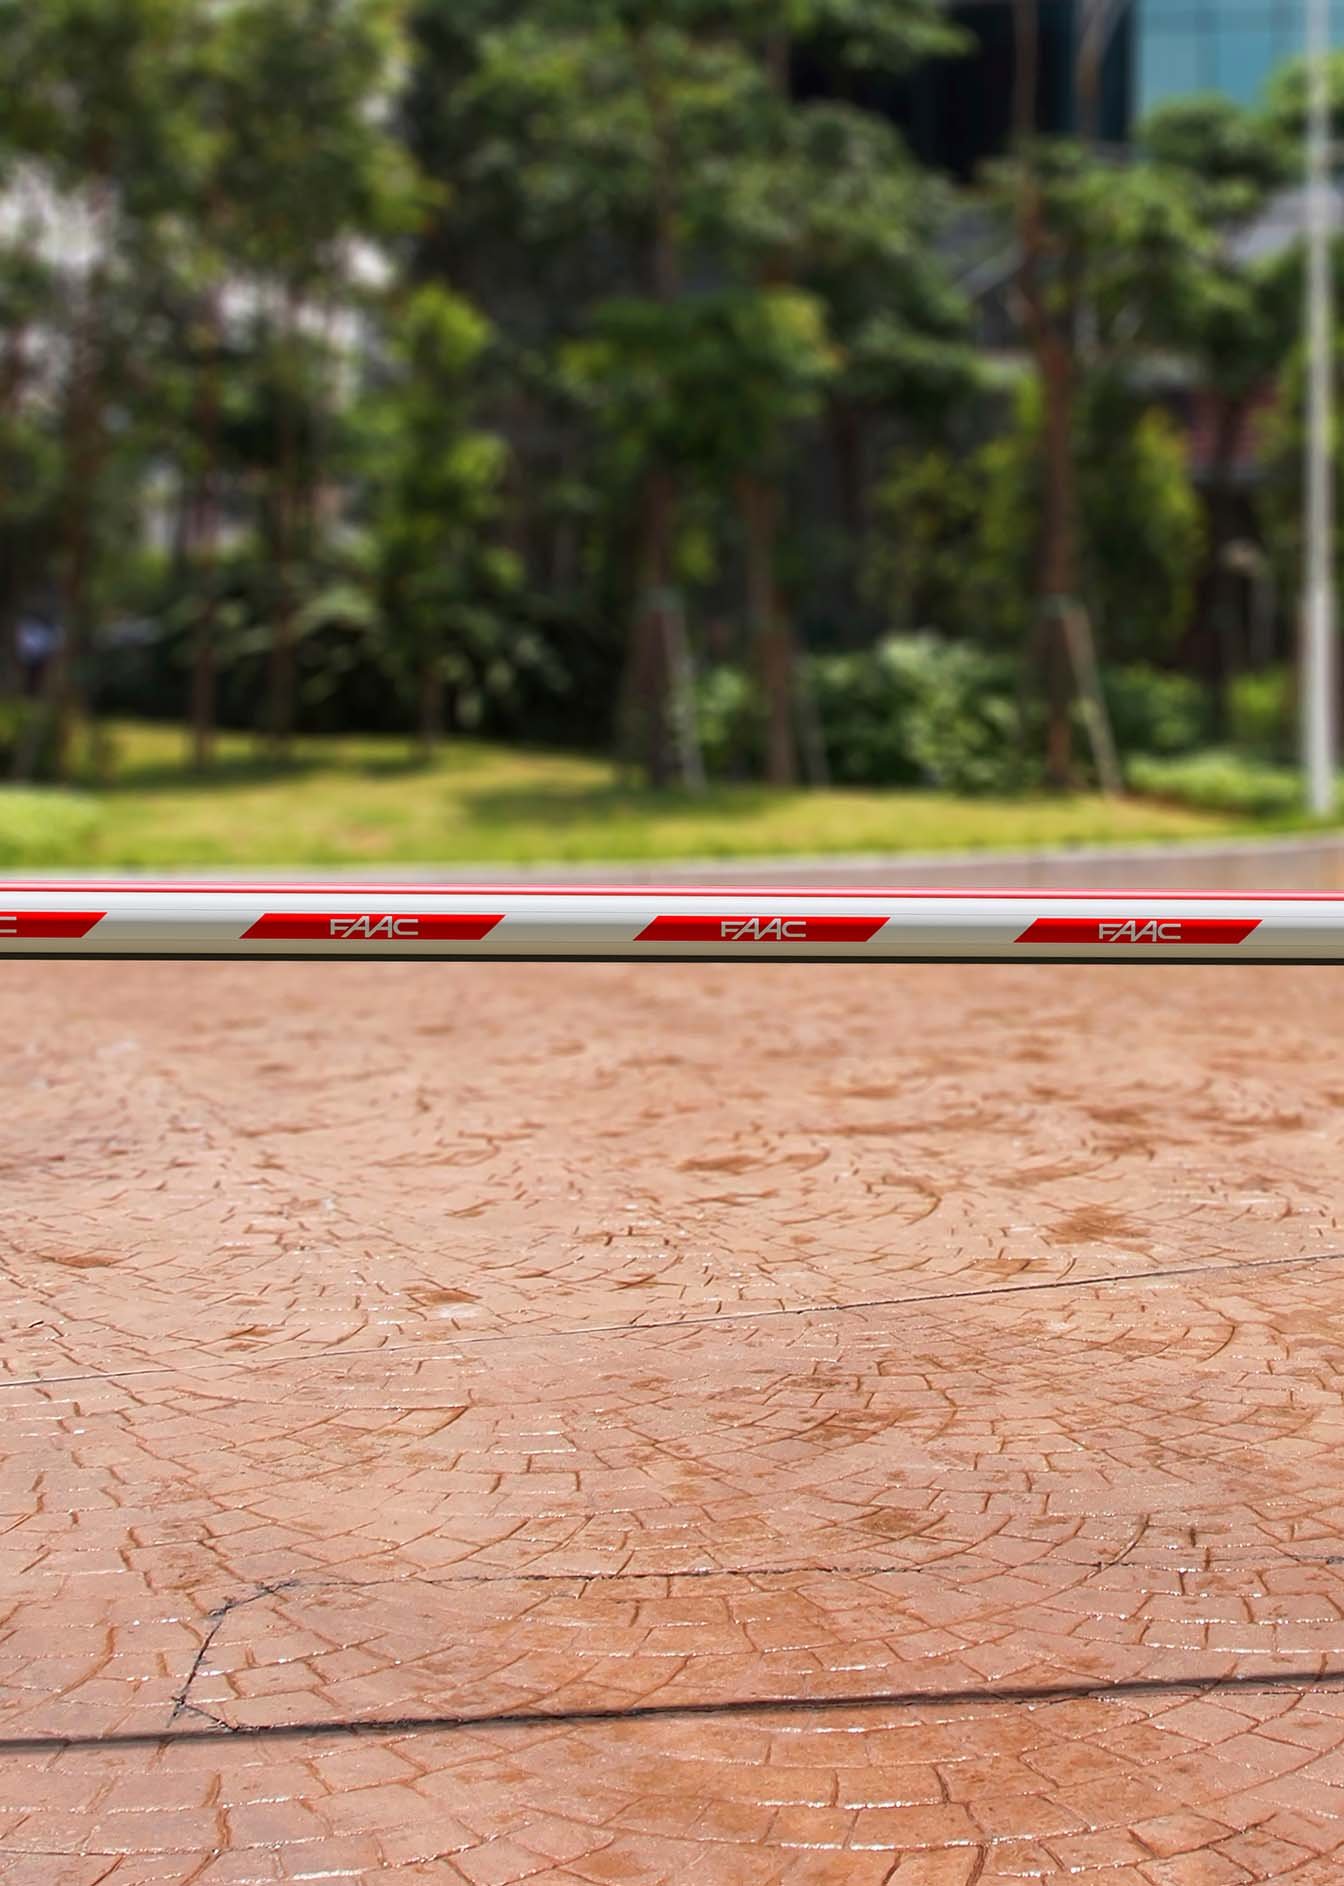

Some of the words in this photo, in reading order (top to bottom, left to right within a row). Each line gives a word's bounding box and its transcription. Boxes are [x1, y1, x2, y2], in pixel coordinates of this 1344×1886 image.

[330, 915, 419, 938] FAAC
[720, 917, 807, 940] FAAC
[1098, 919, 1182, 942] FAAC
